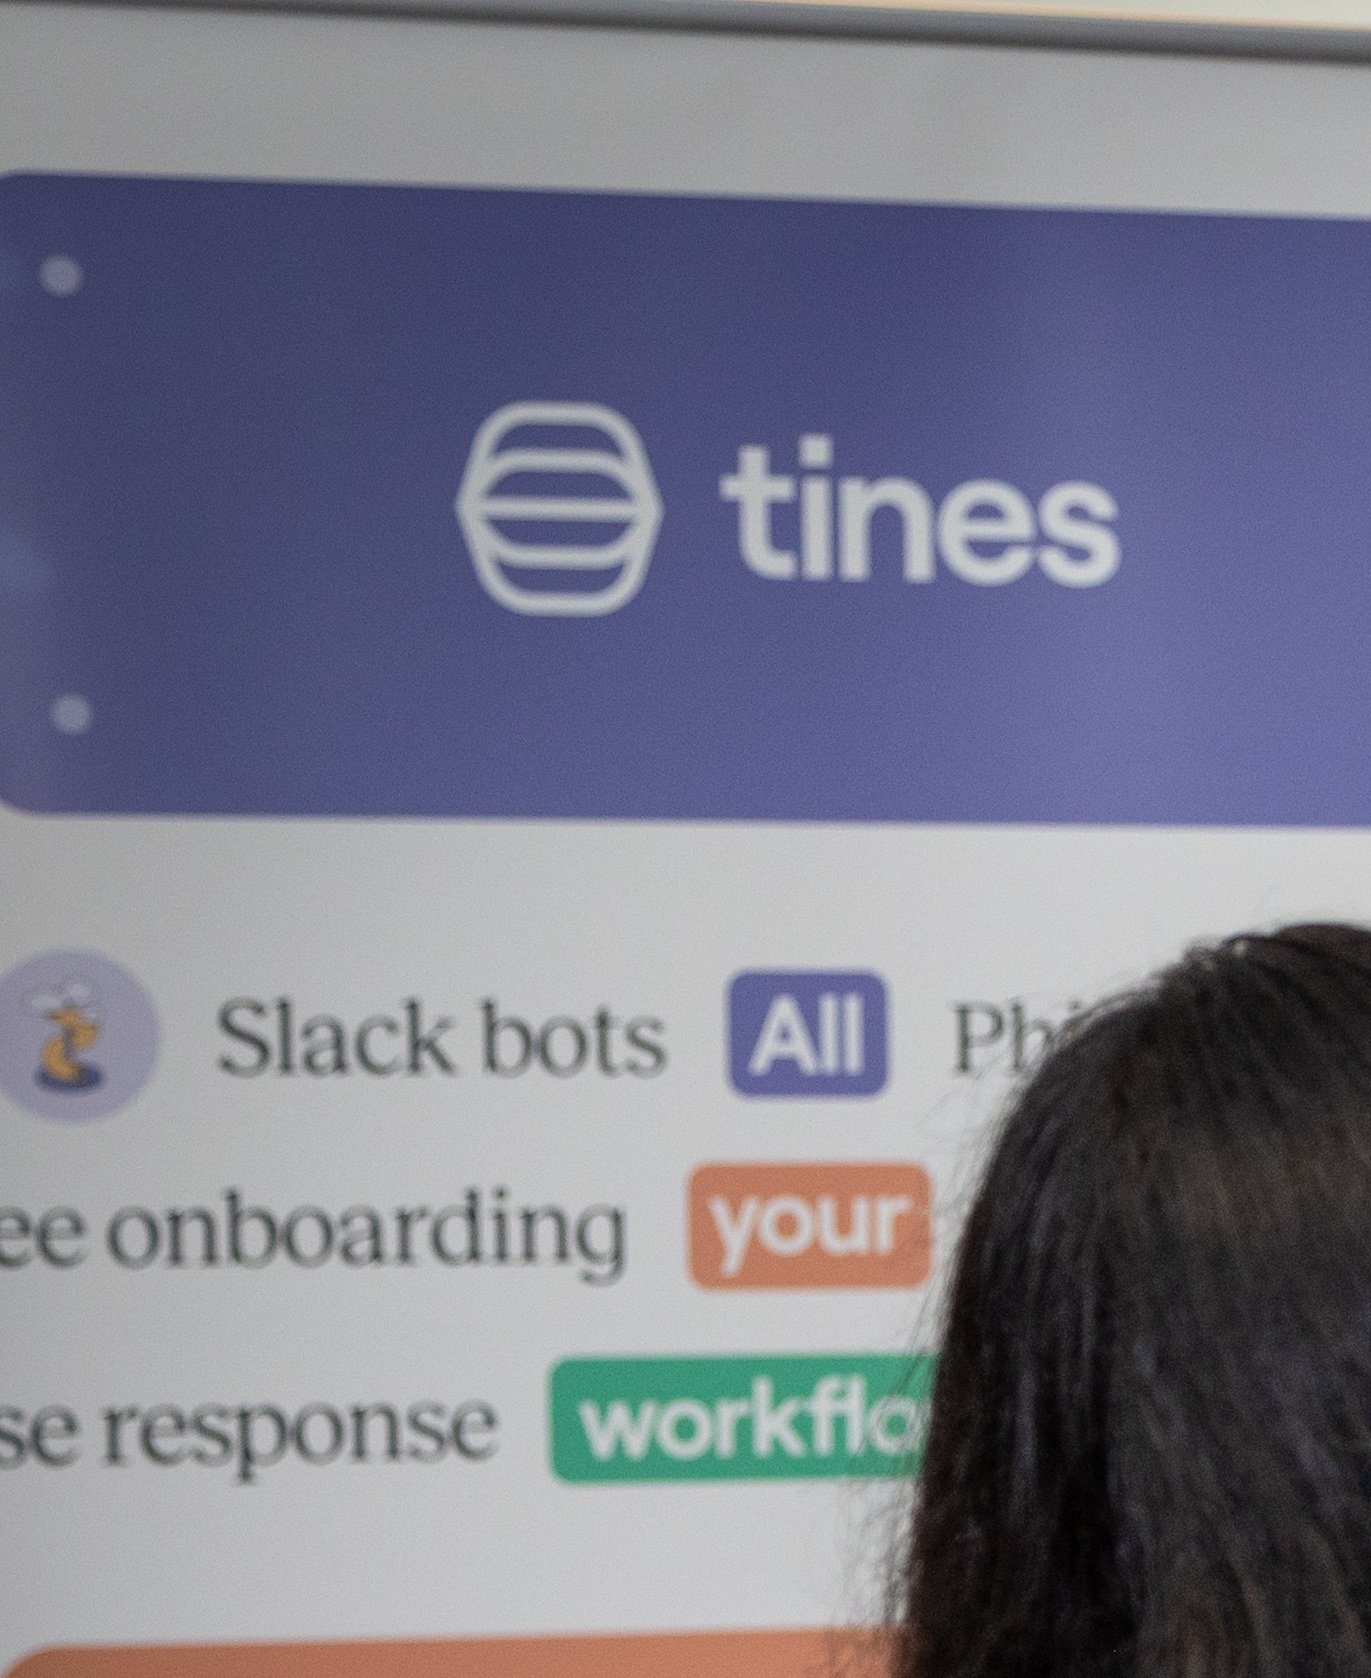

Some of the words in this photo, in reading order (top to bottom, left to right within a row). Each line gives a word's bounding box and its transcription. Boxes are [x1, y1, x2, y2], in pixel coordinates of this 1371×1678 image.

[719, 434, 1121, 588] tines
[216, 995, 457, 1081] Slack
[482, 997, 668, 1080] bots
[749, 992, 864, 1076] All
[107, 1187, 628, 1287] onboarding
[708, 1192, 913, 1278] your
[102, 1400, 499, 1487] response
